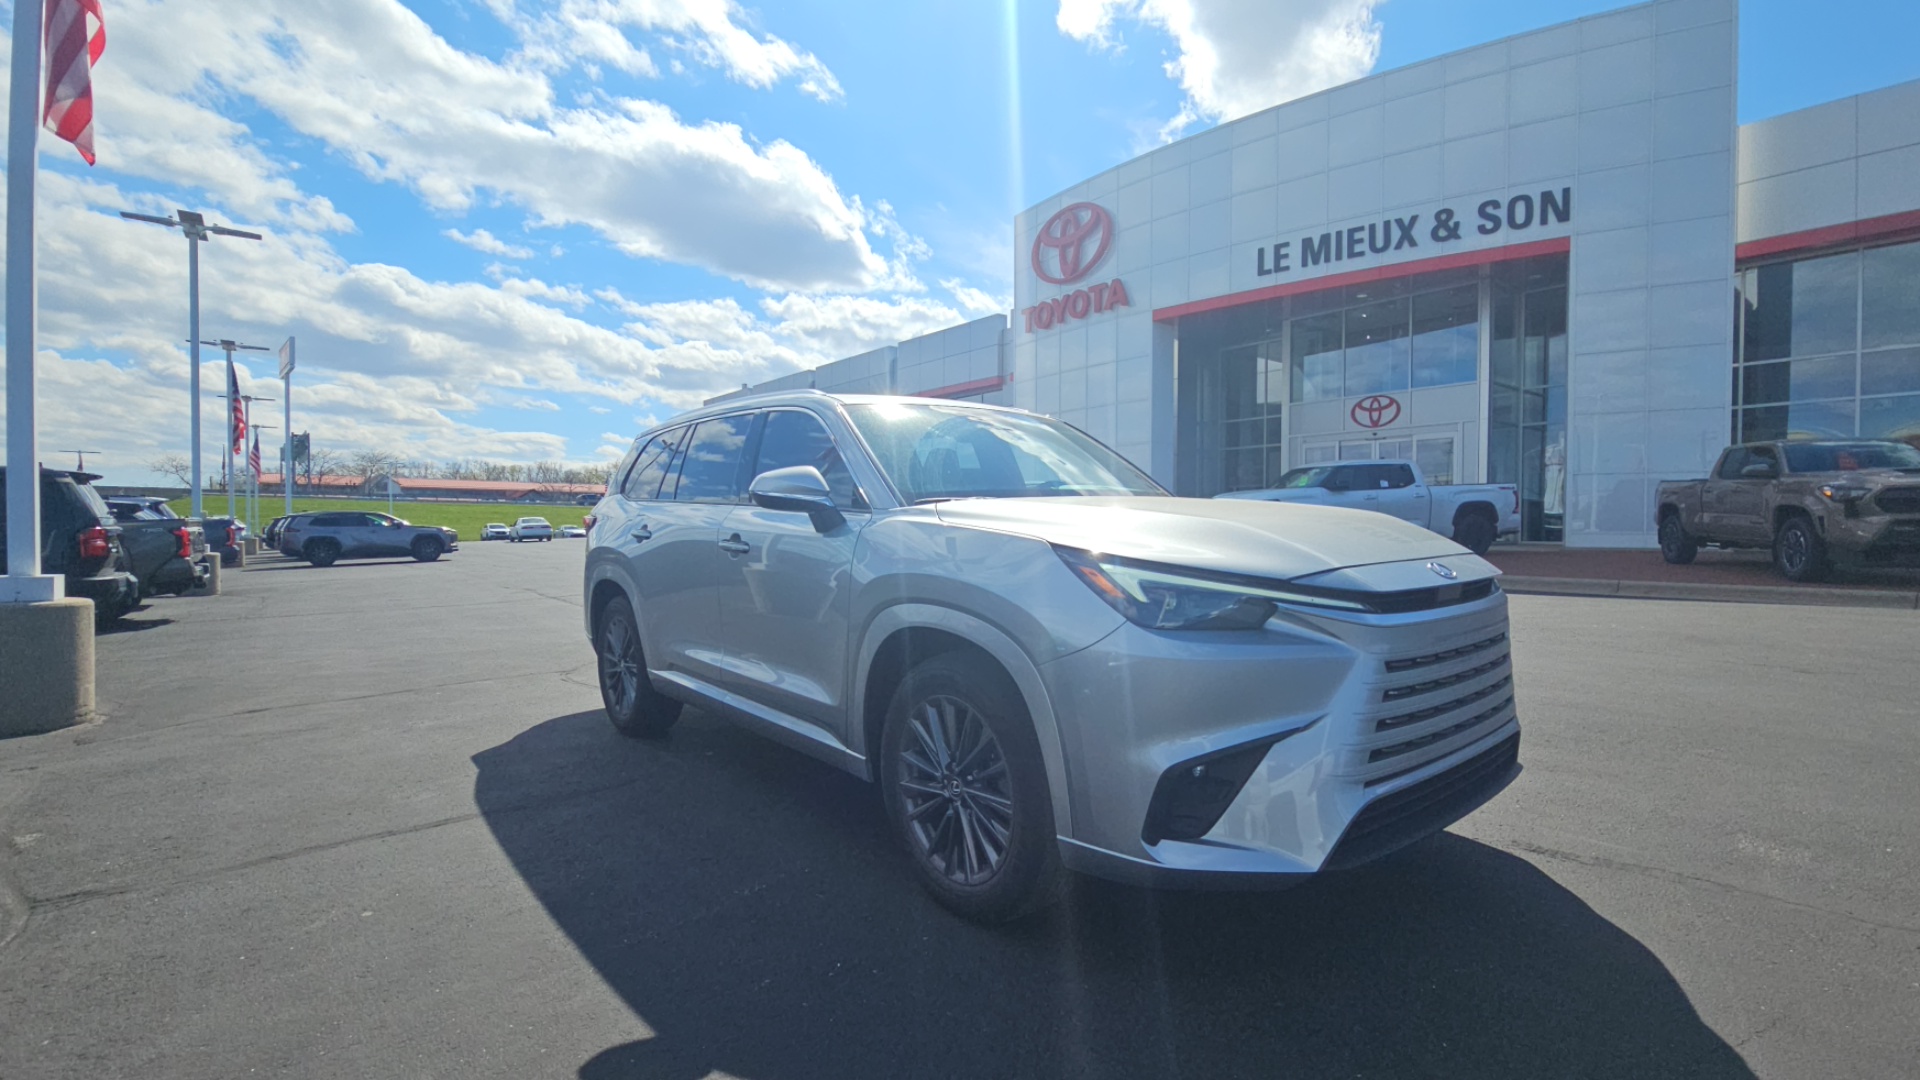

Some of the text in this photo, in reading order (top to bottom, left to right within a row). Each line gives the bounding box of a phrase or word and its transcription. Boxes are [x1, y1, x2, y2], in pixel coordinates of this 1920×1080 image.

[1257, 187, 1571, 277] LE MIEUX & SON
[1022, 278, 1130, 334] TOYOTA
